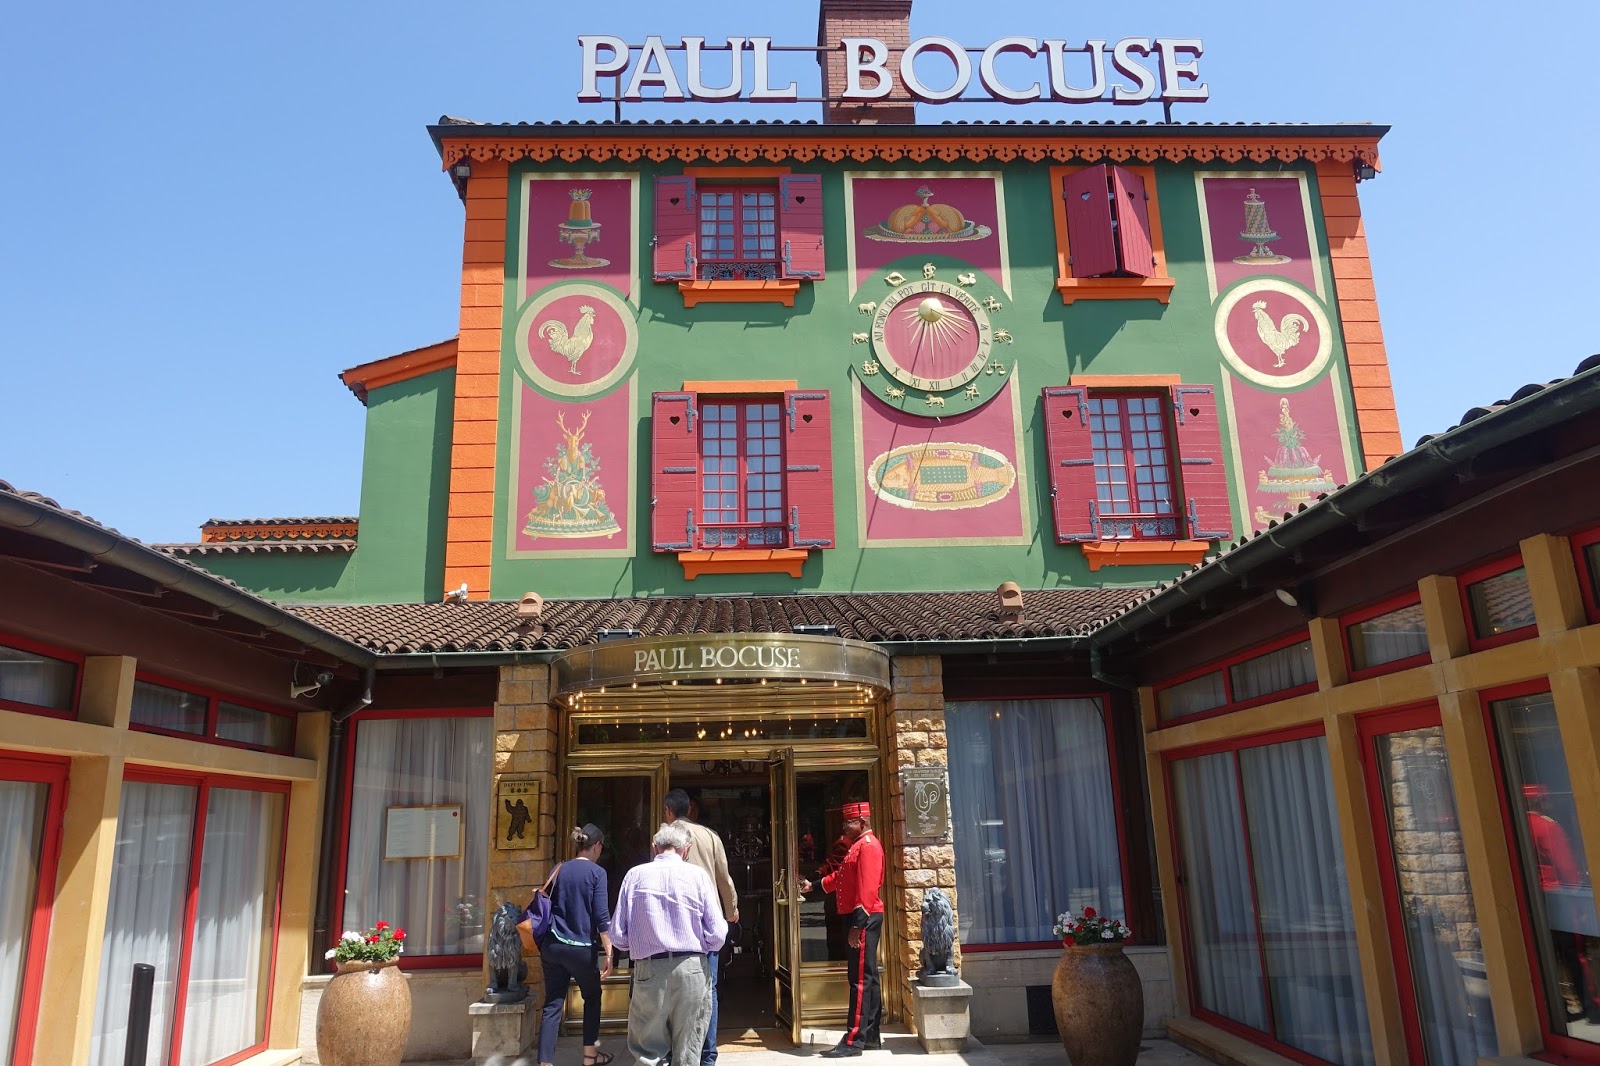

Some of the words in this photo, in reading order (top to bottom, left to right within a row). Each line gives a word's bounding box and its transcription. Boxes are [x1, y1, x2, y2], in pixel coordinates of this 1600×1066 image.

[577, 35, 797, 102] PAUL
[840, 36, 1209, 104] BOCUSE
[897, 285, 915, 299] POT
[921, 281, 936, 292] GÎT
[940, 284, 951, 295] LA
[885, 295, 898, 308] DU
[955, 289, 981, 315] VÉRITÉ
[874, 308, 889, 329] FOND
[874, 331, 884, 343] AU
[980, 338, 990, 346] V
[892, 366, 900, 377] X
[970, 362, 980, 373] III
[960, 372, 969, 381] II
[911, 378, 920, 388] XI
[928, 380, 940, 390] XII
[633, 647, 694, 672] PAUL
[700, 645, 800, 669] BOCUSE
